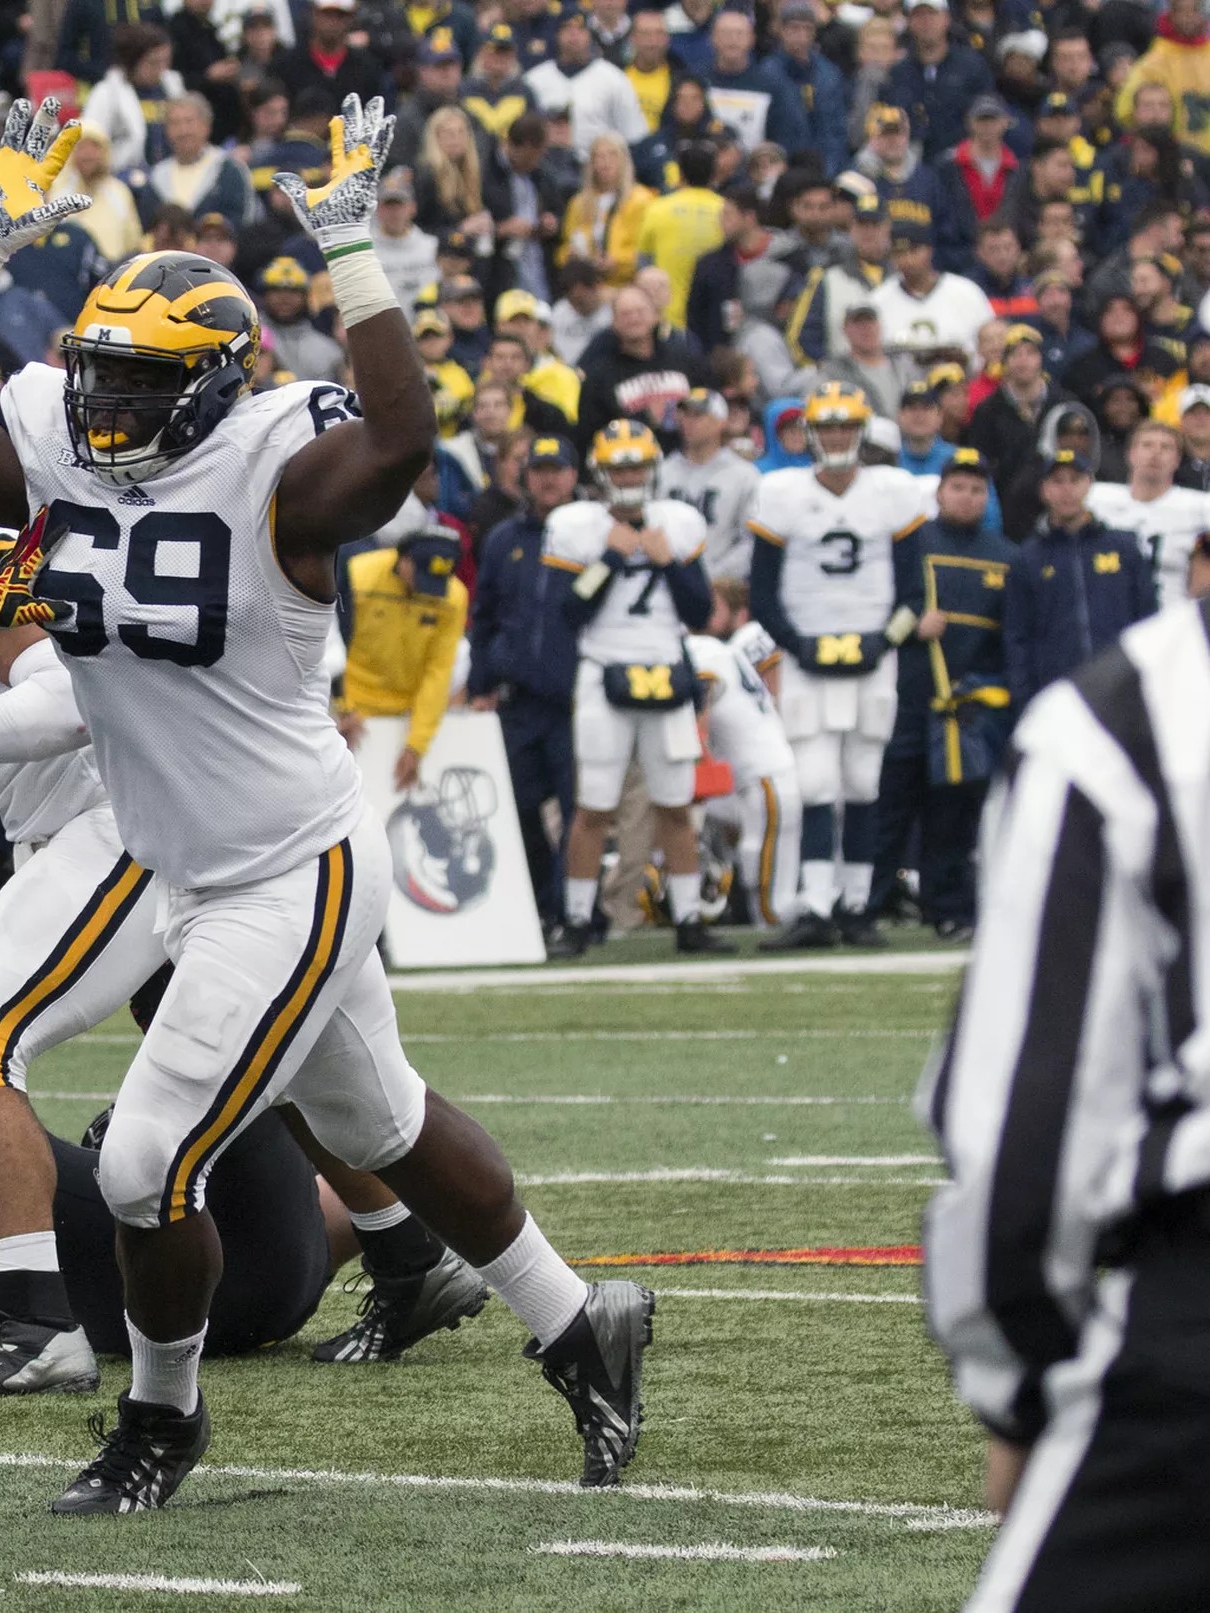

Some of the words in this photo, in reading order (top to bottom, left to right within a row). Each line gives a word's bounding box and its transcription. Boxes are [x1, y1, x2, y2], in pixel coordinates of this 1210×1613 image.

[99, 328, 111, 340] M
[820, 532, 860, 575] 3
[33, 499, 232, 668] 69
[624, 565, 664, 615] 7
[816, 633, 862, 665] M
[626, 664, 674, 700] M
